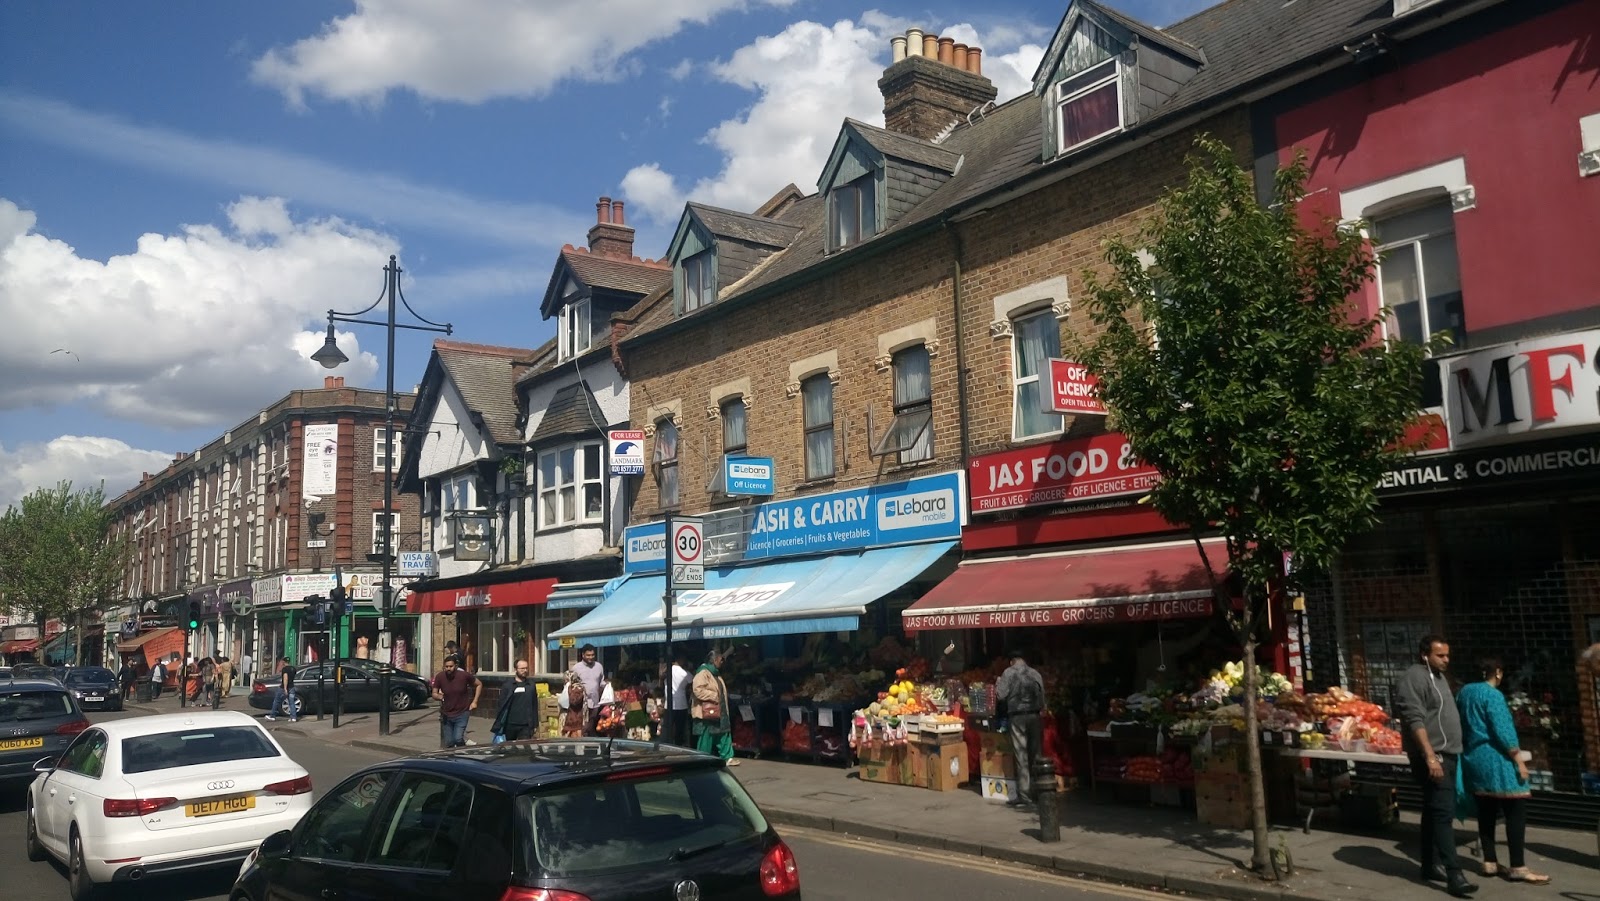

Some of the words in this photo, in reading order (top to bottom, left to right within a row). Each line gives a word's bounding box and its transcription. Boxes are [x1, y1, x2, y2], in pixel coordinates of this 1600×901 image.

[1451, 344, 1600, 434] MF
[1060, 398, 1076, 406] OPEN
[740, 466, 766, 474] Lebara
[988, 460, 1025, 492] JAS
[1032, 448, 1108, 482] FOOD
[1454, 463, 1468, 480] &
[734, 480, 743, 488] Off
[744, 481, 766, 489] Licence
[980, 498, 1000, 509] FRUIT
[1002, 497, 1007, 506] &
[1008, 494, 1024, 506] VEG
[1029, 488, 1066, 502] GROCERS
[1073, 485, 1089, 497] OFF
[1090, 481, 1126, 494] LICENCE
[793, 506, 806, 528] &
[810, 495, 870, 526] CARRY
[896, 496, 946, 516] Lebara
[922, 512, 946, 522] mobile
[679, 536, 697, 551] 30
[750, 541, 771, 550] Licence
[775, 536, 804, 548] Groceries
[808, 533, 826, 543] Fruits
[827, 532, 833, 540] &
[833, 529, 870, 541] Vegetables
[455, 590, 492, 607] Ladbrokes
[686, 588, 782, 608] Lebara
[906, 617, 921, 628] JAS
[923, 616, 947, 627] FOOD
[949, 615, 955, 626] &
[958, 614, 981, 625] WINE
[989, 612, 1018, 624] FRUIT
[1020, 612, 1026, 623] &
[1030, 610, 1052, 622] VEG.
[1062, 606, 1115, 621] GROCERS
[1127, 604, 1149, 617] OFF
[1153, 600, 1204, 616] LICENCE
[23, 738, 40, 746] XAS
[192, 801, 220, 814] DE17
[224, 797, 248, 810] HGO
